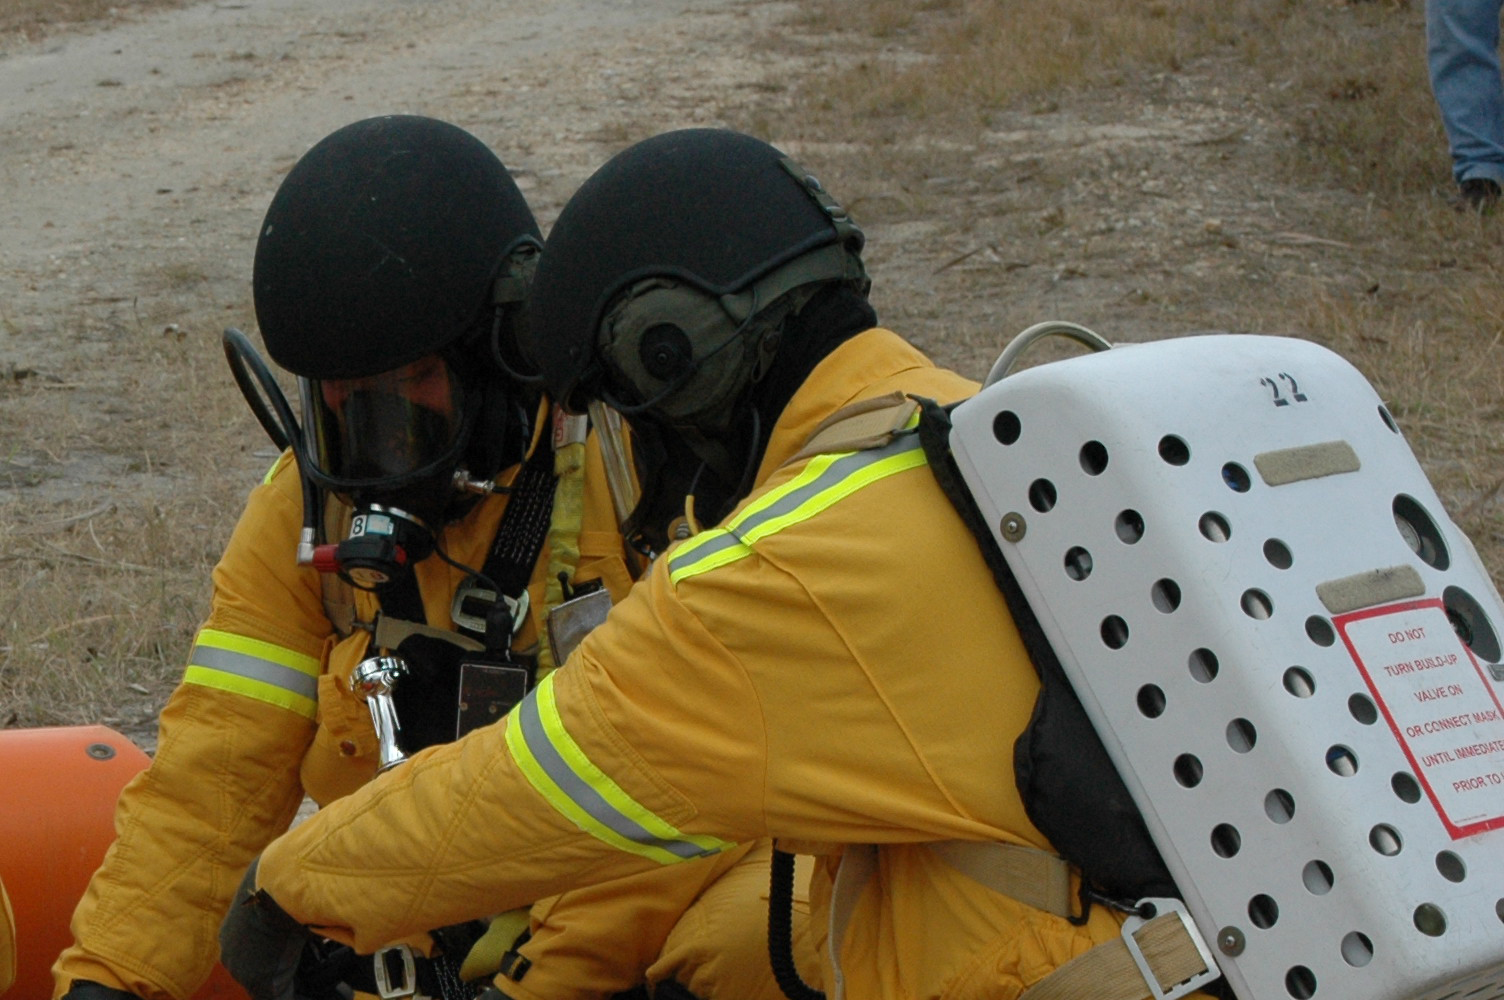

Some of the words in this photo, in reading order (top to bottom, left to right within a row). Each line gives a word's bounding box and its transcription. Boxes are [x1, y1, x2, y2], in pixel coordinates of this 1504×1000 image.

[1260, 372, 1308, 407] 22
[352, 517, 363, 535] 8
[1388, 632, 1405, 644] DO
[1405, 627, 1426, 641] NOT
[1384, 662, 1414, 677] TURN
[1414, 654, 1459, 672] BUILD-UP
[1414, 688, 1447, 703] VALVE
[1447, 684, 1463, 697] ON
[1406, 725, 1424, 738] OR
[1424, 714, 1472, 733] CONNECT
[1472, 710, 1500, 723] MASK
[1422, 751, 1455, 767] UNTIL
[1454, 740, 1504, 759] IMMEDIATE
[1453, 777, 1487, 793] PRIOR
[1485, 773, 1501, 785] TO
